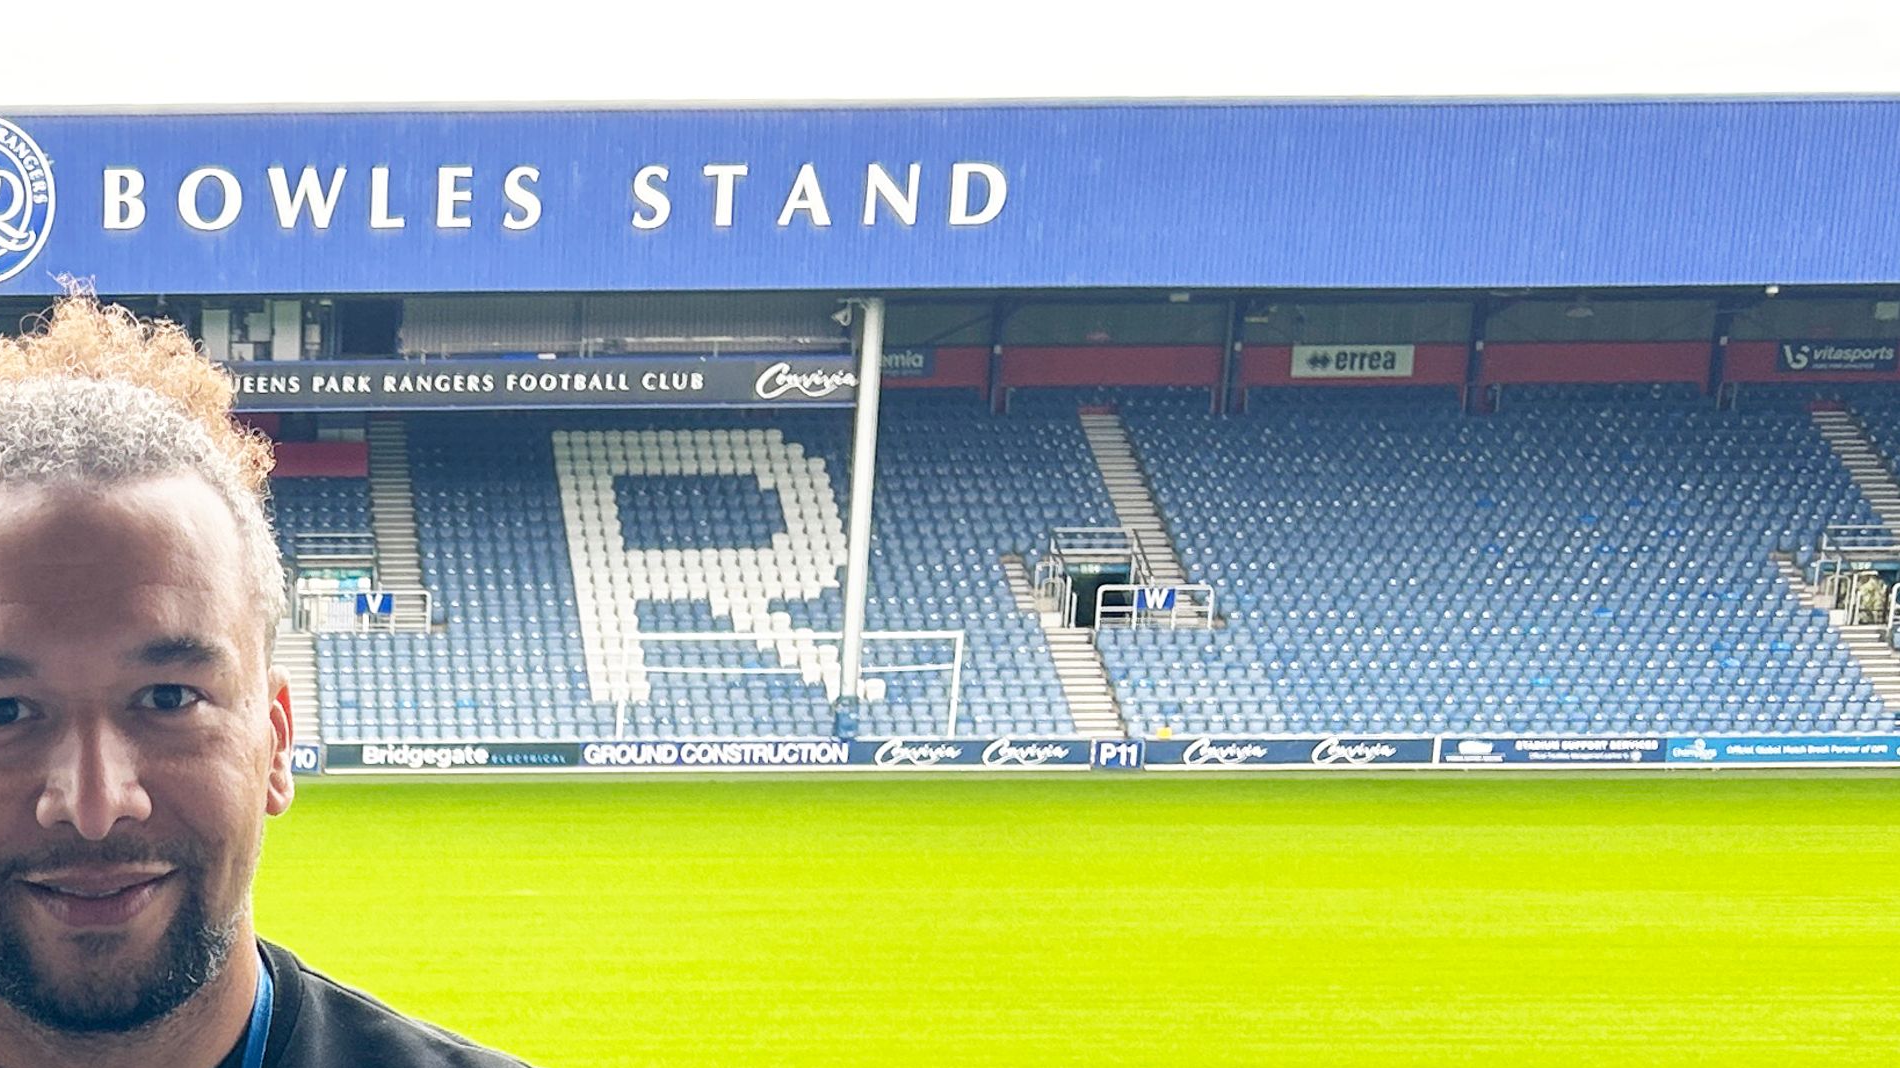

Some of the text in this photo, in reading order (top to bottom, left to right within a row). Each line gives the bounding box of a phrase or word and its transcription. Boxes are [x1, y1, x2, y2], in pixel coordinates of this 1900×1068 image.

[102, 162, 1009, 232] BOWLES STAND
[1335, 350, 1397, 370] errea
[1813, 345, 1894, 362] vitasports
[233, 371, 704, 394] UEENS PARK RANGERS FOOTBALL CLUB
[365, 593, 384, 613] V
[1144, 588, 1169, 609] W
[291, 748, 317, 769] 10
[362, 744, 567, 768] Bridgegate ELECTRICAL
[583, 742, 849, 765] GROUND CONSTRUCTION
[1099, 743, 1138, 767] P11
